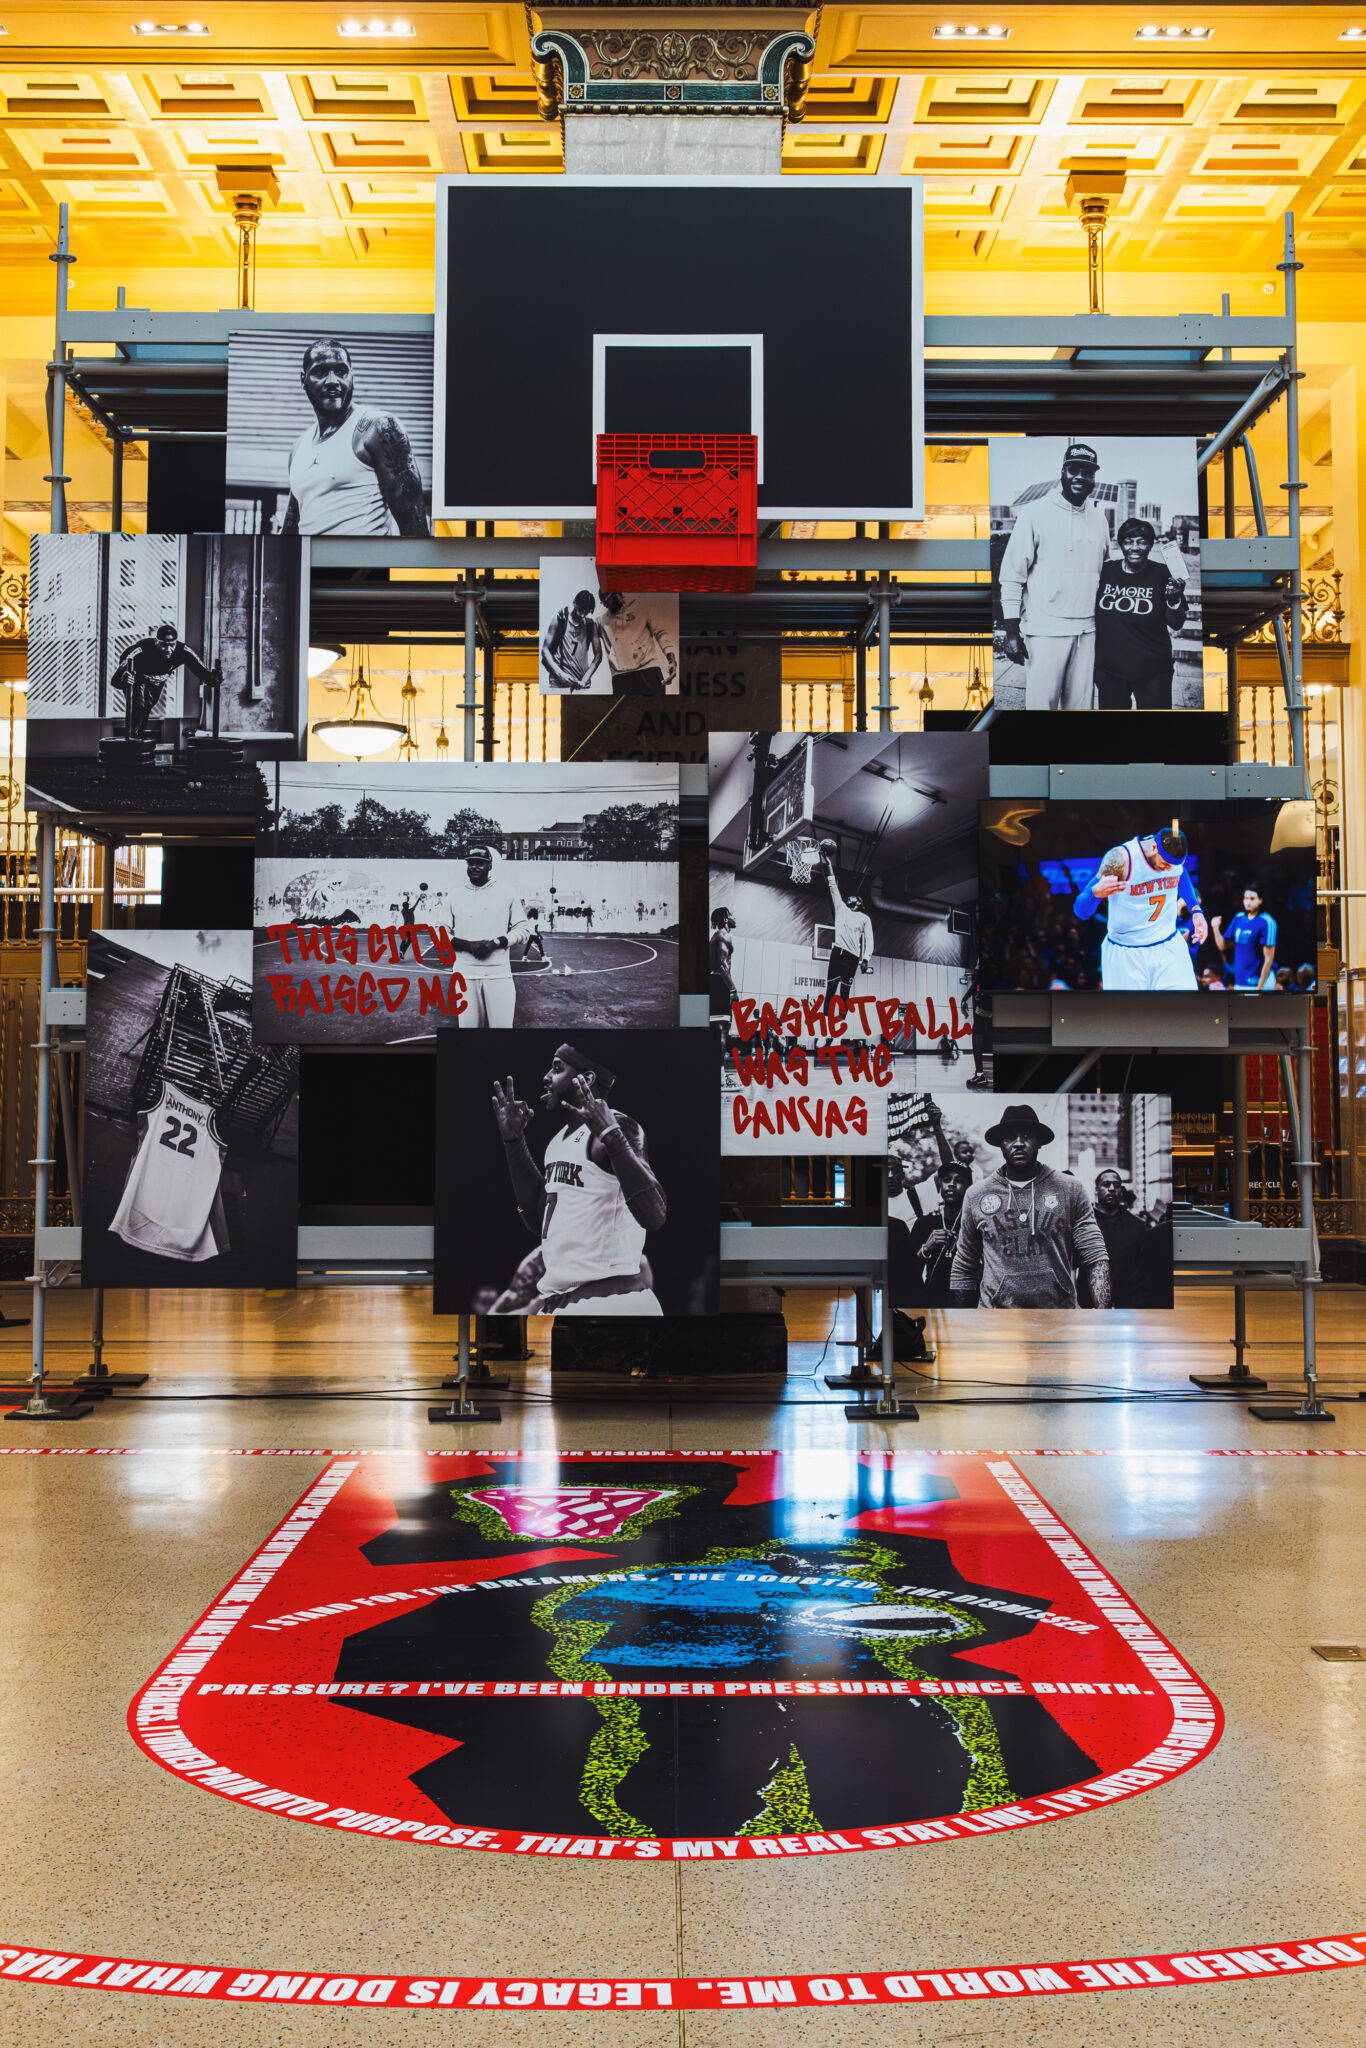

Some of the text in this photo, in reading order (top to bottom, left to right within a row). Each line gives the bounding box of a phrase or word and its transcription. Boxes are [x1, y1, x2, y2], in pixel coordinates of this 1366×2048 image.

[1099, 594, 1153, 614] GOD
[636, 712, 706, 736] AND
[1130, 880, 1155, 896] NEW
[1148, 894, 1166, 921] 7
[267, 924, 457, 966] THIS CITY
[266, 970, 468, 1018] RAISED ME
[810, 978, 826, 988] TIME
[732, 994, 973, 1042] BASKETBALL
[732, 1044, 894, 1089] WAS THE
[166, 1096, 205, 1124] ANTHONY
[732, 1094, 868, 1138] CANVAS
[160, 1116, 198, 1158] 22
[1224, 1448, 1308, 1456] LEGACY
[249, 1552, 291, 1568] YOUR
[237, 1568, 278, 1583] LAST
[1078, 1580, 1121, 1596] SOUL
[218, 1584, 267, 1604] NAME.
[266, 1603, 360, 1628] STAND
[352, 1591, 414, 1608] FOR
[411, 1584, 470, 1596] THE
[474, 1572, 658, 1590] DREAMERS,
[670, 1573, 726, 1581] THE
[727, 1574, 881, 1592] DOUBTED,
[894, 1586, 955, 1600] THE
[1090, 1597, 1131, 1608] MY
[207, 1605, 250, 1619] YOU
[1101, 1609, 1145, 1623] AND
[194, 1620, 238, 1635] ARE
[1112, 1624, 1160, 1639] FIRE
[181, 1636, 227, 1651] NOT
[1126, 1640, 1169, 1651] ON
[161, 1652, 215, 1675] YOUR
[1136, 1652, 1193, 1679] HEART
[197, 1682, 1155, 1695] PRESSURE? I'VE BEEN UNDER PRESSURE SINCE BIRTH.
[1158, 1680, 1206, 1695] MY
[136, 1676, 196, 1726] SETBACKS.
[1169, 1695, 1216, 1720] WITH
[1162, 1719, 1216, 1749] GAME
[141, 1730, 218, 1770] TURNED
[1131, 1747, 1199, 1772] THIS
[185, 1766, 269, 1796] PAIN
[1050, 1768, 1164, 1807] PLAYED
[240, 1789, 330, 1816] INTO
[1035, 1799, 1076, 1812] I
[312, 1808, 502, 1849] PURPOSE.
[950, 1799, 1059, 1833] LINE.
[515, 1834, 661, 1858] THAT'S
[748, 1834, 863, 1855] REAL
[861, 1821, 960, 1847] STAT
[672, 1840, 739, 1858] MY
[1170, 1940, 1365, 1978] OPENED
[72, 1962, 224, 1994] WHAT
[881, 1967, 1072, 1999] WORLD
[1068, 1960, 1175, 1988] THE
[226, 1973, 397, 2004] DOING
[404, 1980, 457, 2005] IS
[469, 1981, 673, 2006] LEGACY
[698, 1980, 797, 2004] ME.
[807, 1978, 877, 2001] TO
